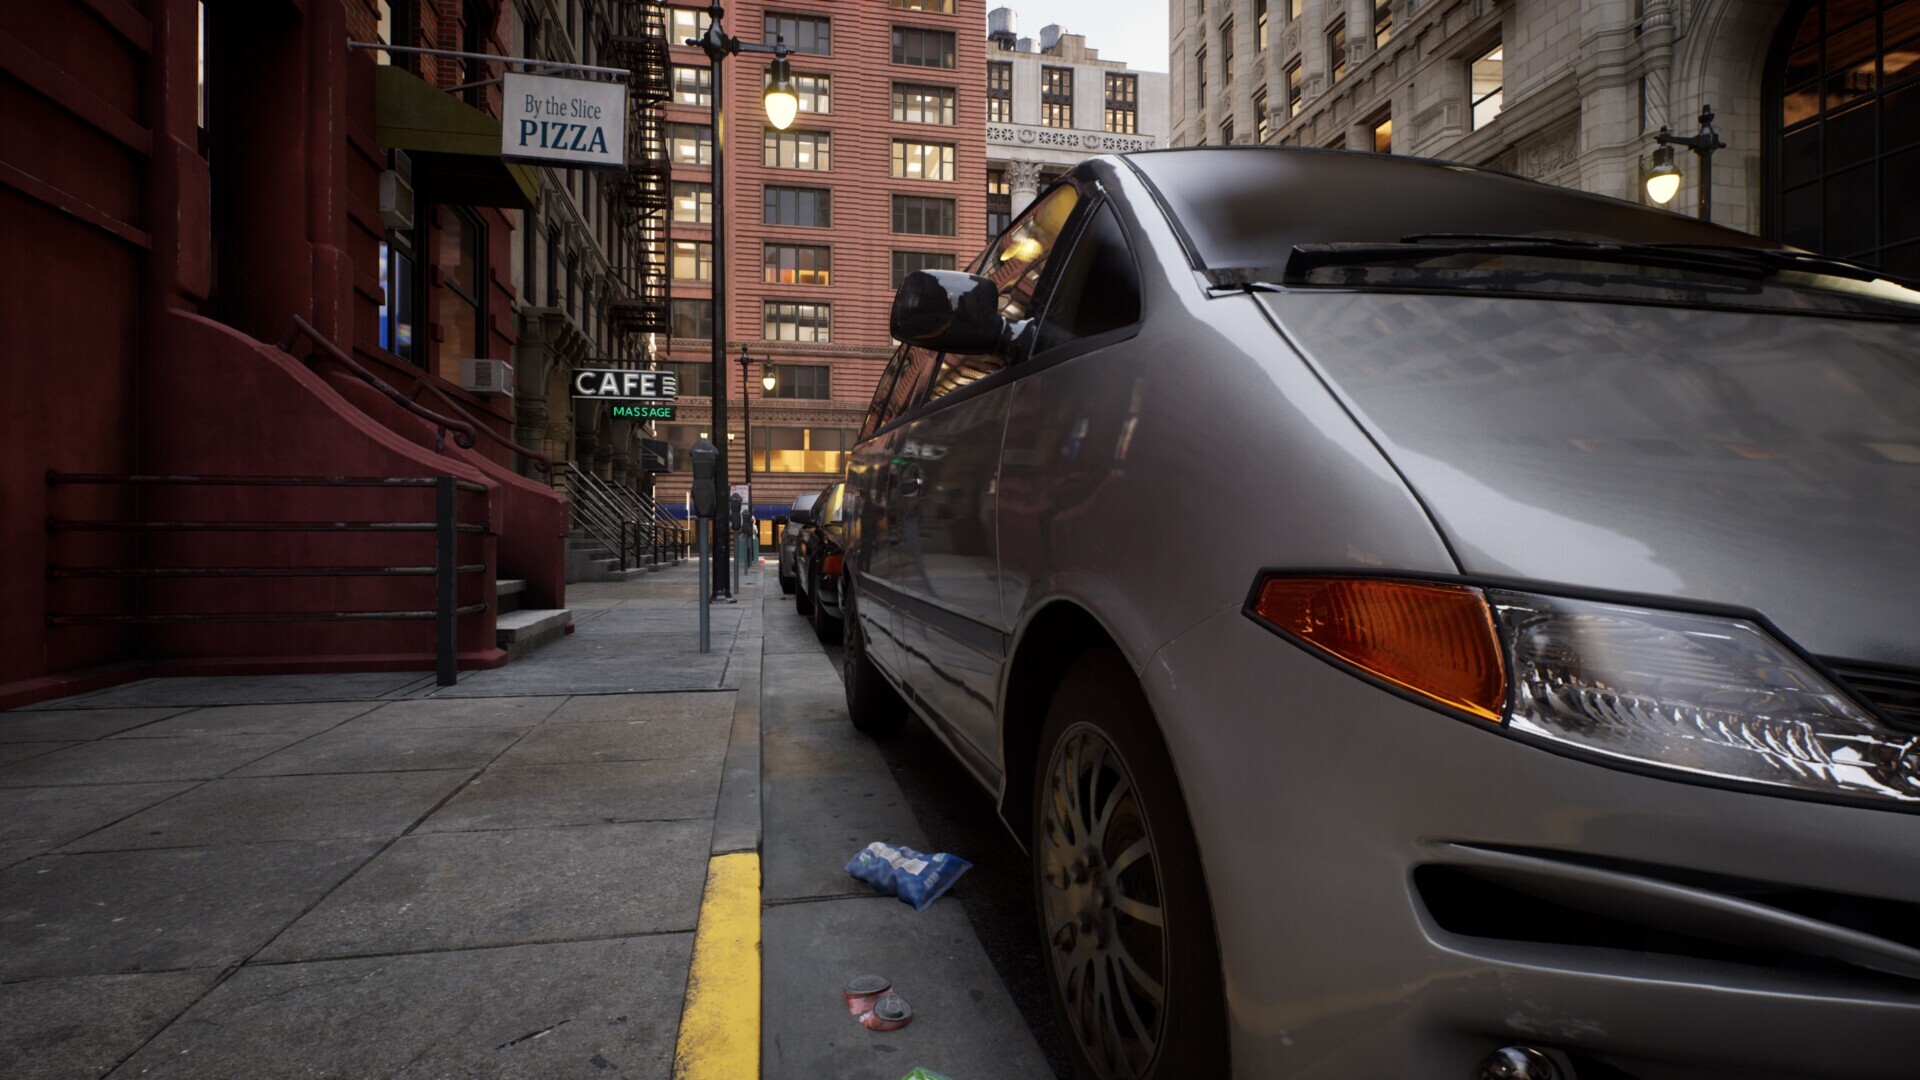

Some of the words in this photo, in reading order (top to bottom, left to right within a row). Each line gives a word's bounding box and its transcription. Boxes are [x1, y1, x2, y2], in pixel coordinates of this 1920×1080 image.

[525, 94, 542, 119] By
[546, 96, 567, 116] the
[570, 99, 601, 119] Slice
[519, 119, 608, 154] PIZZA
[575, 372, 657, 396] CAFE
[613, 406, 671, 418] MASSAGE
